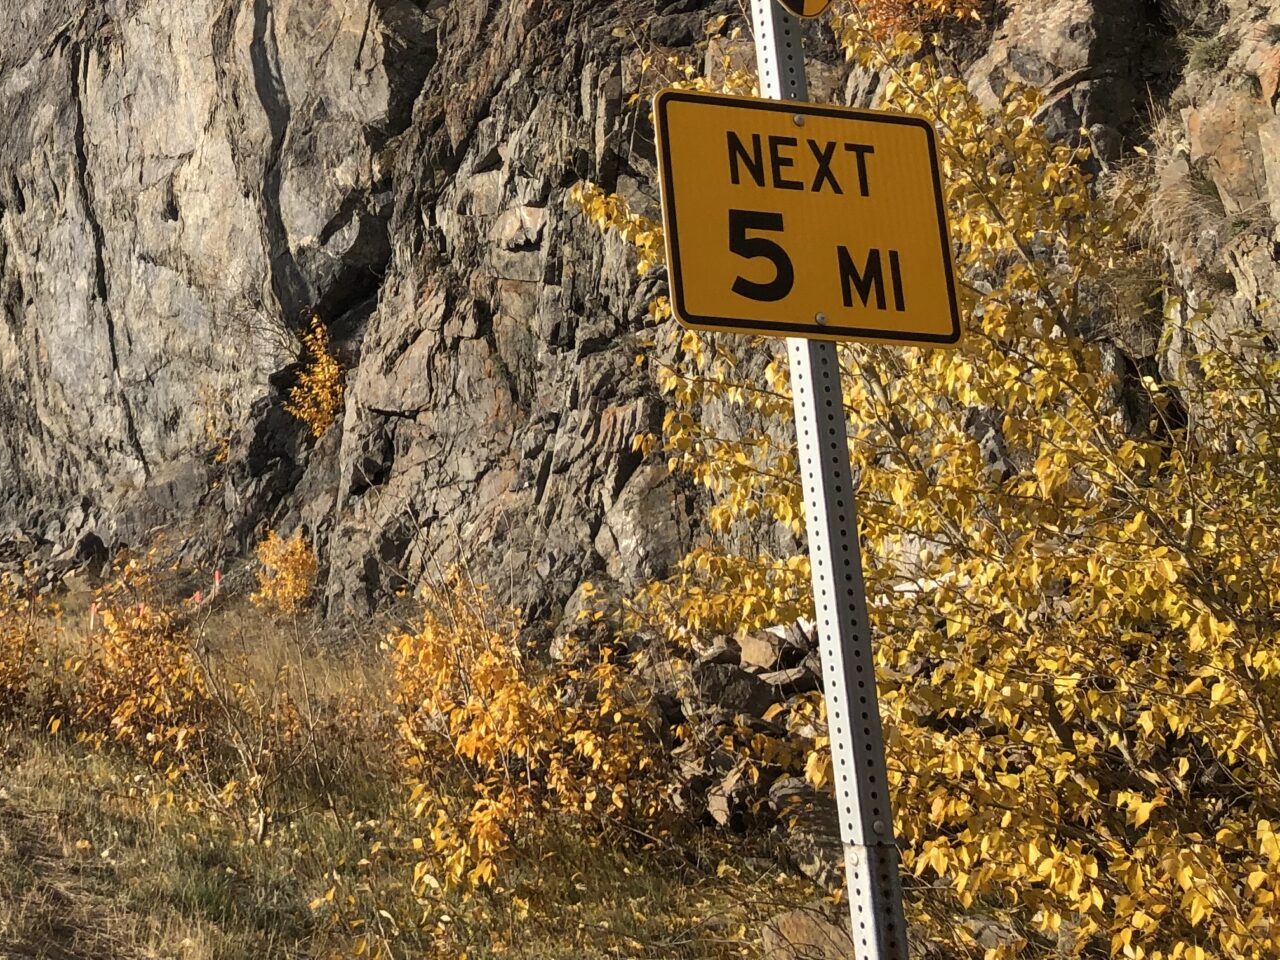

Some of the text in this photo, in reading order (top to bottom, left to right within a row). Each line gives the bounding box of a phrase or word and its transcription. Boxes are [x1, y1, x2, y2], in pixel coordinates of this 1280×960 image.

[726, 130, 875, 197] NEXT
[728, 208, 906, 312] 5 MI
